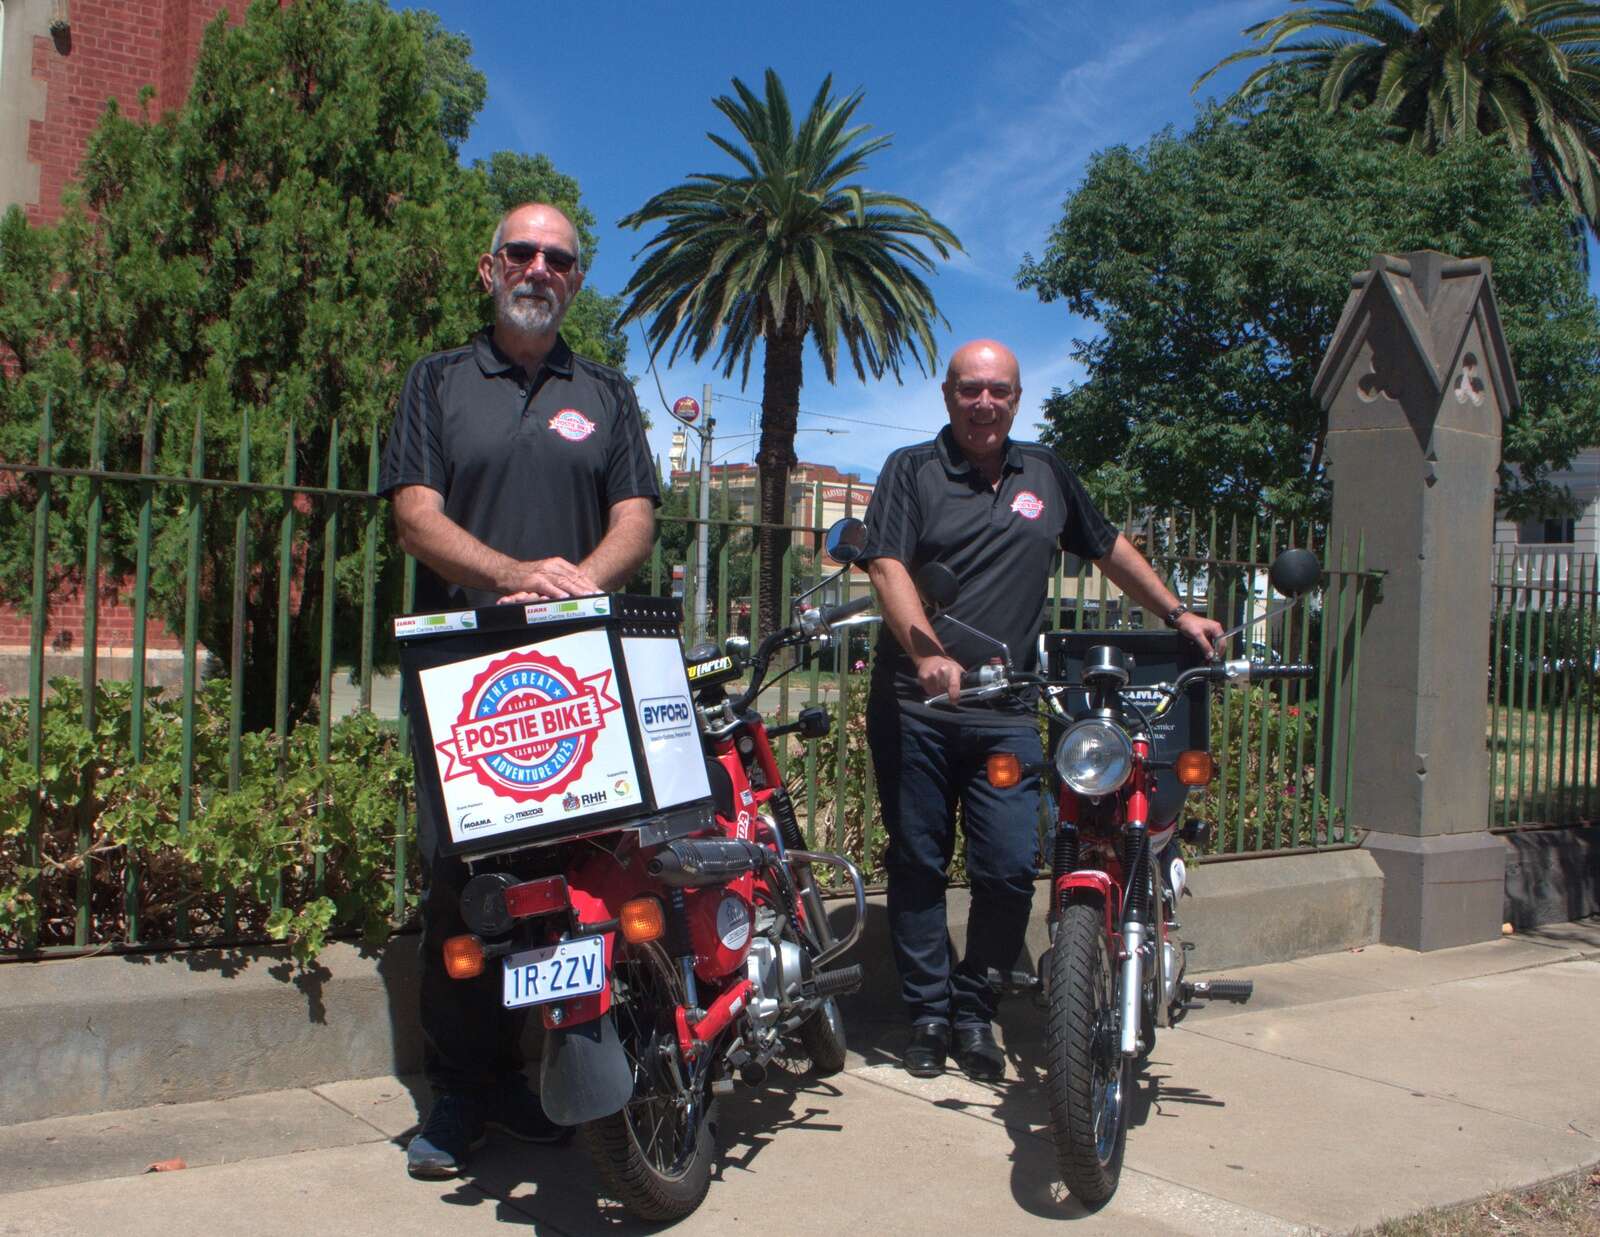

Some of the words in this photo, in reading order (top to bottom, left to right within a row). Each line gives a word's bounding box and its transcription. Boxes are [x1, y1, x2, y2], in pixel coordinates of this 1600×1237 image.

[486, 680, 508, 704] THE
[512, 671, 555, 690] GREAT
[514, 701, 527, 710] LAP
[529, 698, 537, 707] OF
[643, 702, 689, 725] BYFORD
[464, 714, 539, 752] POSTIE
[541, 702, 593, 735] BIKE
[514, 743, 550, 758] TASMANIA
[490, 756, 552, 782] ADVENTURE
[551, 740, 573, 769] 2025
[581, 790, 607, 805] RHH
[464, 818, 491, 829] MOAMA
